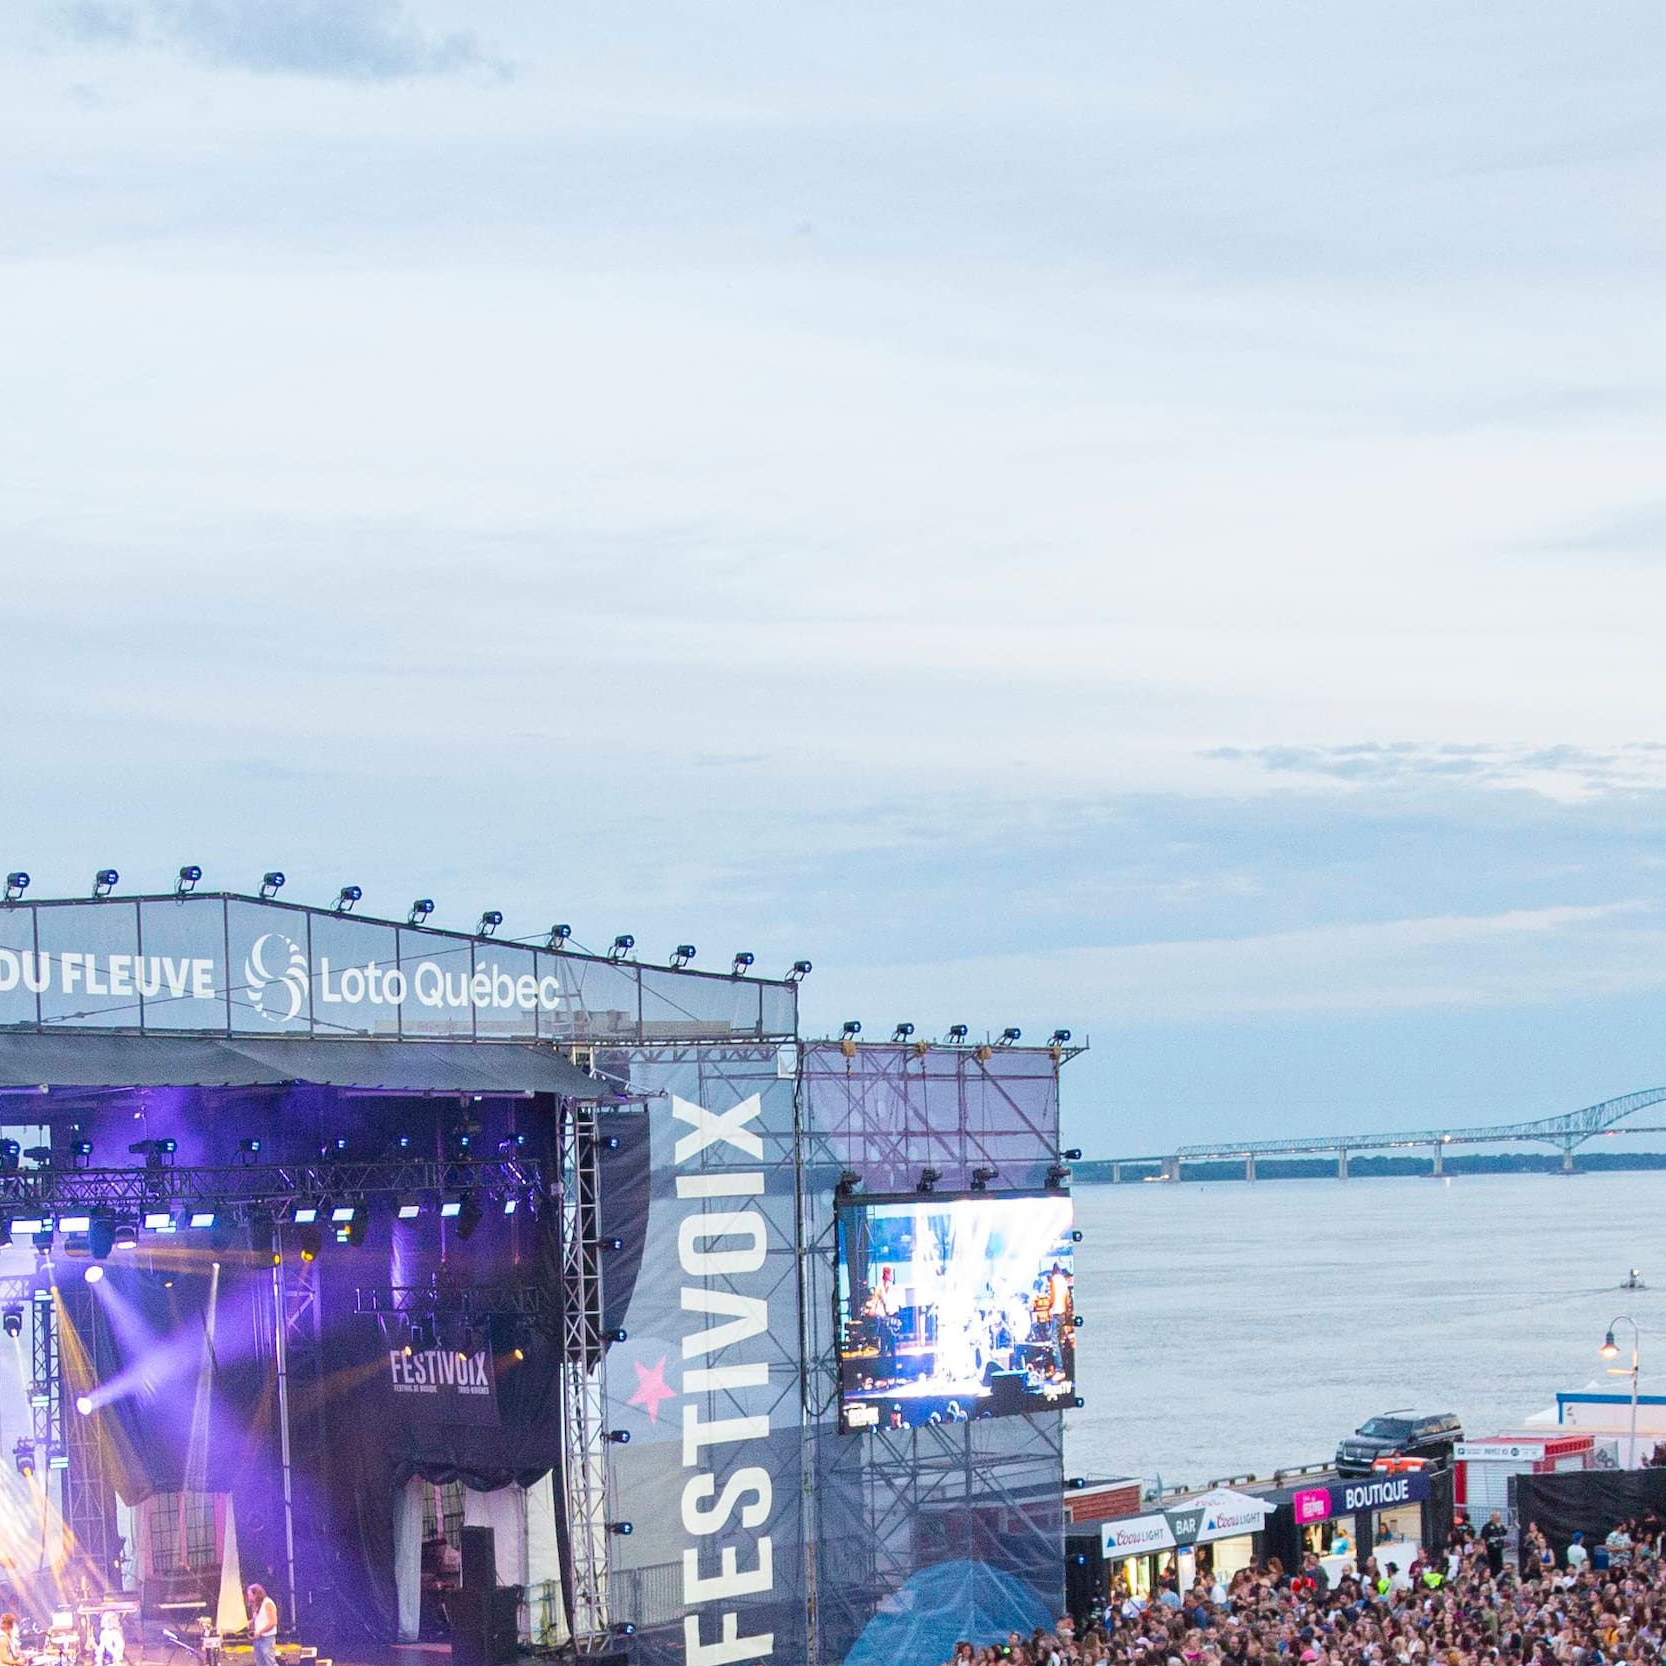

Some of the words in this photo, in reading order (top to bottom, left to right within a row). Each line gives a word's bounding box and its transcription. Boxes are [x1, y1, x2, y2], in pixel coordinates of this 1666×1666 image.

[62, 952, 216, 999] FLEUVE
[321, 957, 407, 1002] Loto
[415, 961, 561, 1010] Québec
[390, 1350, 488, 1386] FESTIVOIX
[1345, 1479, 1410, 1510] BOUTIQUE
[1175, 1519, 1197, 1536] BAR
[1240, 1511, 1262, 1525] LIGHT
[1142, 1528, 1165, 1543] LIGHT
